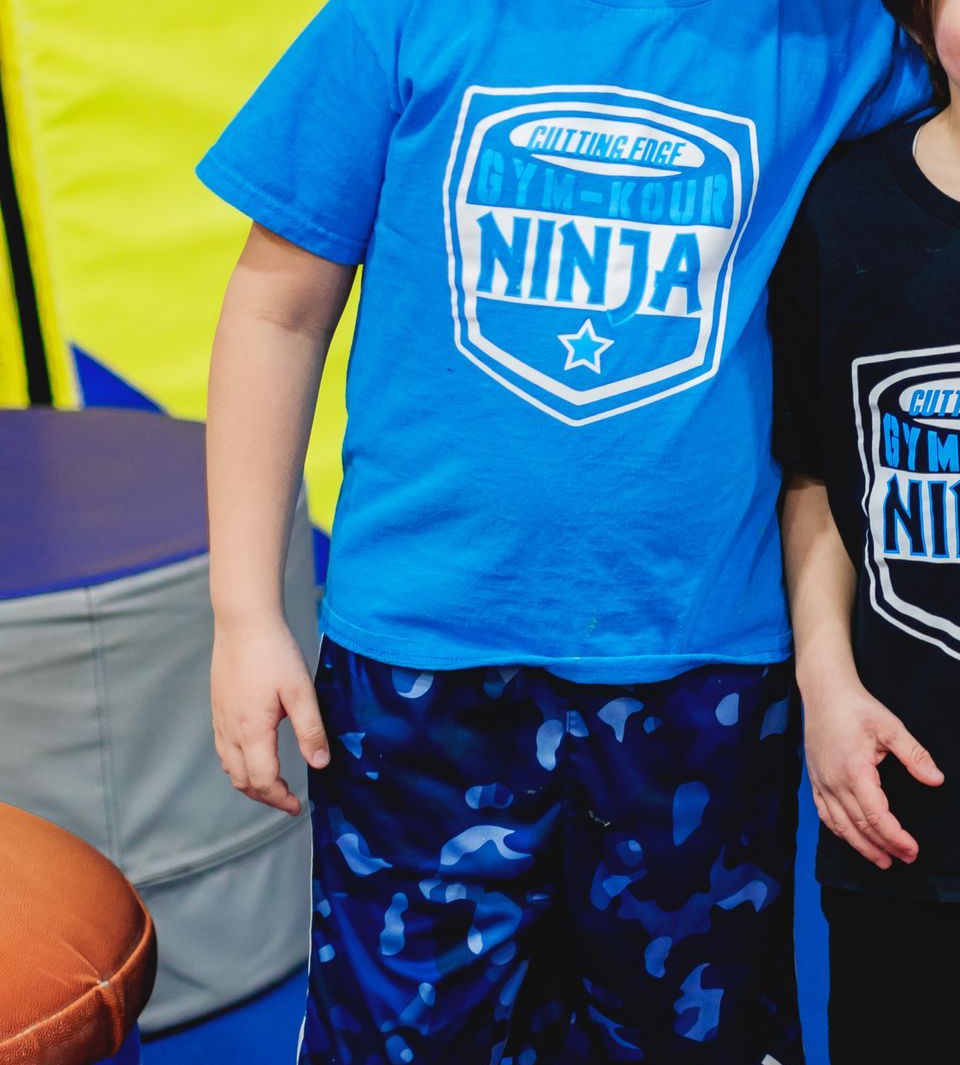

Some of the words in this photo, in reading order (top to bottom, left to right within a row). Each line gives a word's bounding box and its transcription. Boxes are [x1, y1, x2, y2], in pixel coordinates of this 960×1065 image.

[529, 125, 627, 162] CUTTING
[625, 137, 687, 166] EDGE
[476, 149, 729, 224] GYM-KOUR
[476, 212, 704, 327] NINJA
